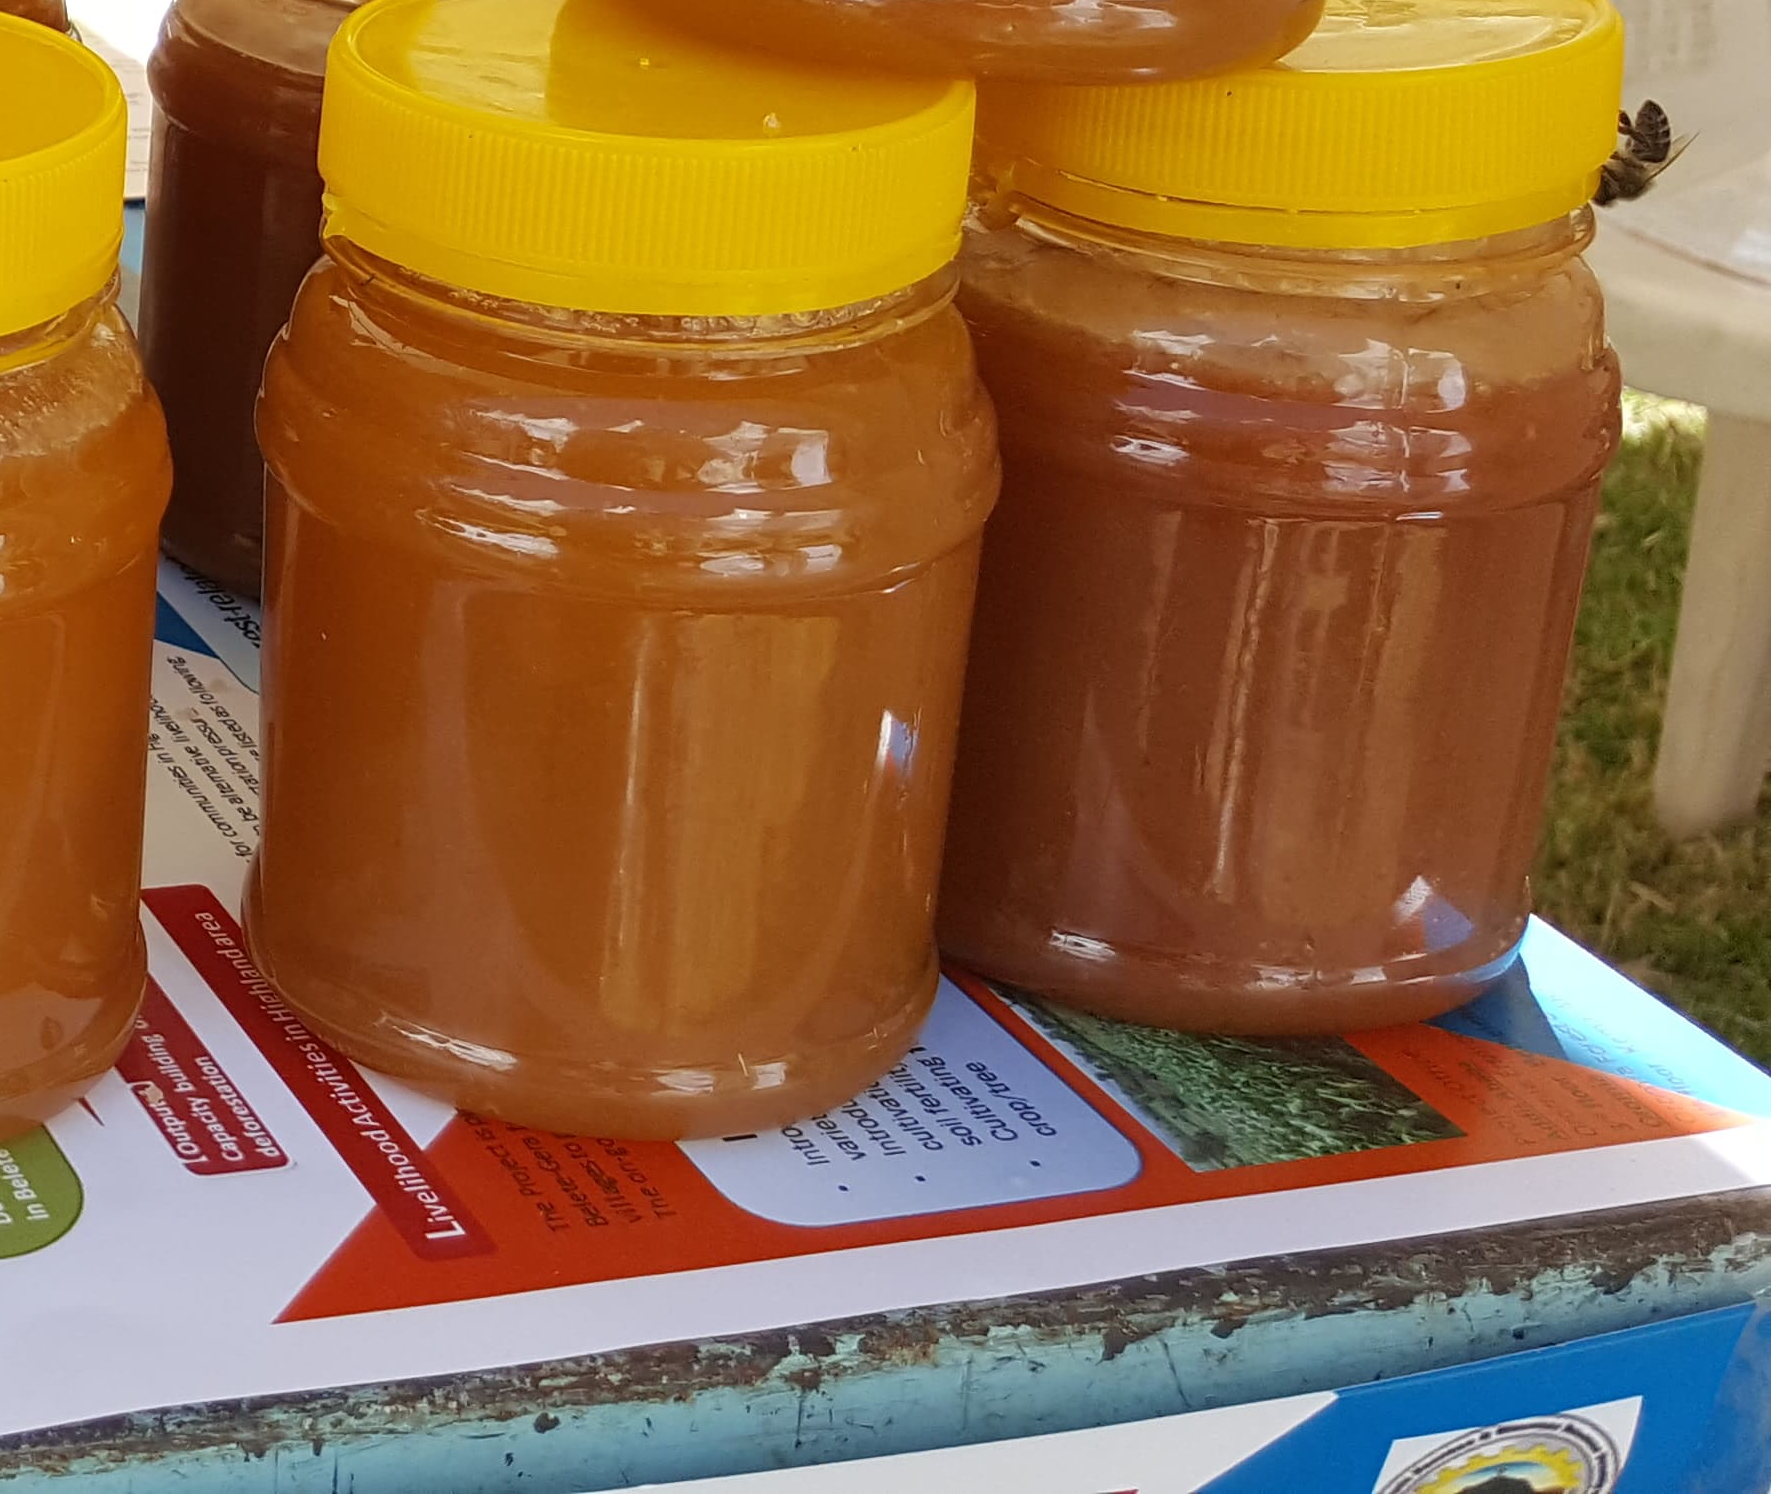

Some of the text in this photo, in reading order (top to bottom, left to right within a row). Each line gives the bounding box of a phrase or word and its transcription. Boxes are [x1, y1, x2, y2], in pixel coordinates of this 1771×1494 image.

[157, 752, 176, 764] in
[184, 745, 245, 806] alternative
[167, 765, 238, 838] communities
[229, 839, 254, 858] for
[140, 1032, 198, 1094] building
[194, 910, 467, 1240] Livelihood Activities in Highland area
[186, 1095, 246, 1162] Capacity
[194, 1056, 282, 1158] deforestation
[916, 1054, 1020, 1143] Cultivating
[963, 1059, 1059, 1139] crop/tree
[934, 1116, 985, 1149] soil
[486, 1144, 544, 1198] Project
[536, 1200, 571, 1233] The
